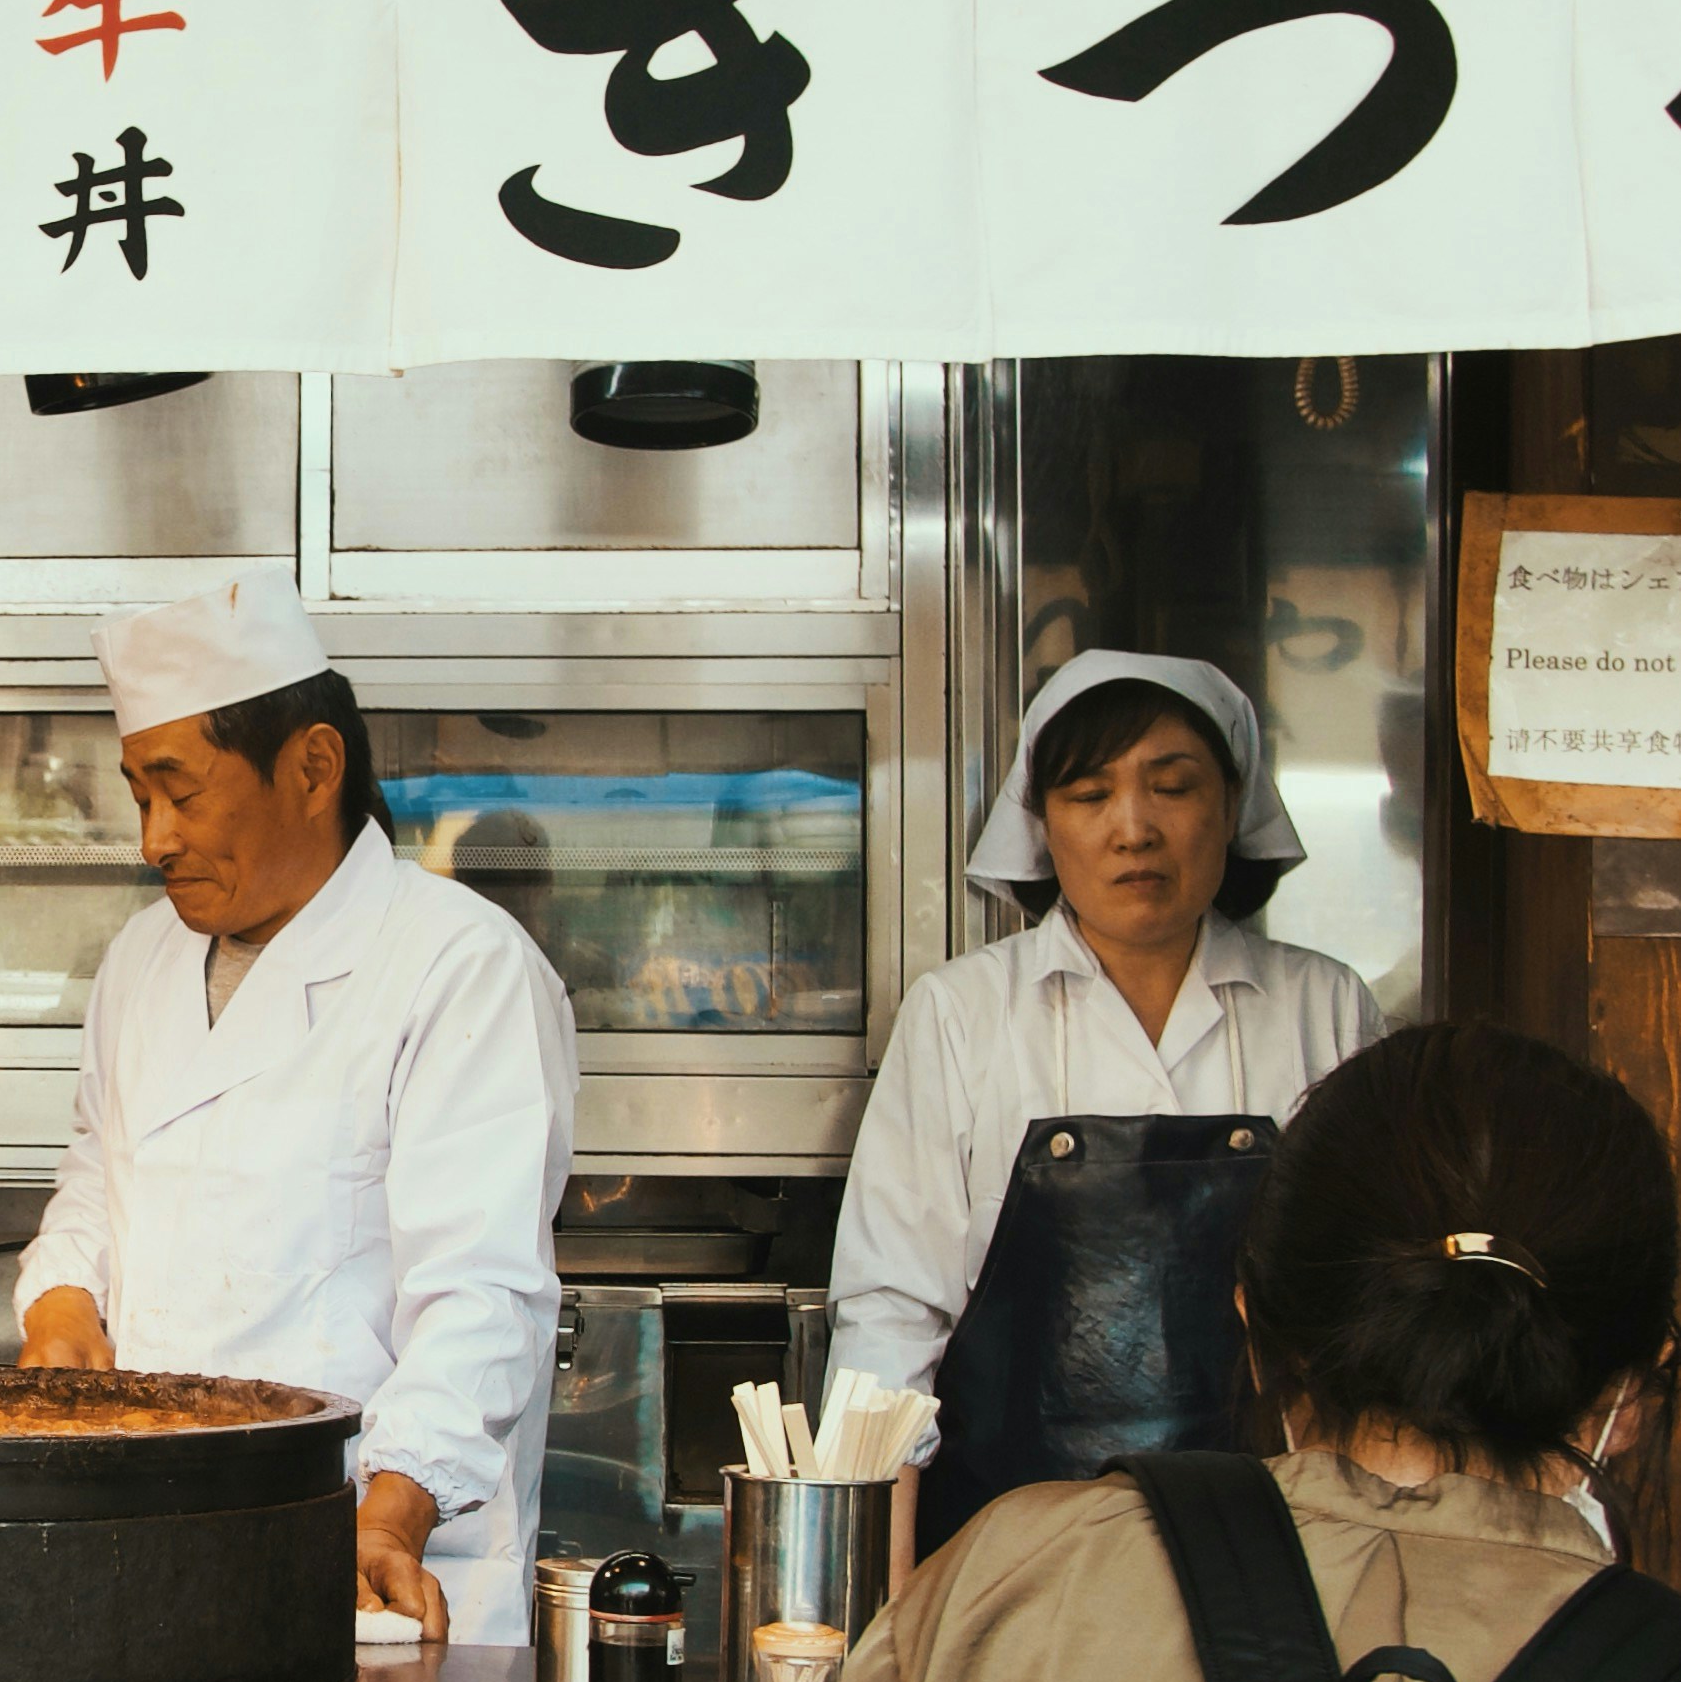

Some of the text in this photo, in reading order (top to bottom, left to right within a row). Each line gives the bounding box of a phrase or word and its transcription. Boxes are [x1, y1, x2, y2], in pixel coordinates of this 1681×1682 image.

[1507, 565, 1681, 591] 食べ物はシェ
[1506, 647, 1676, 673] Please do not
